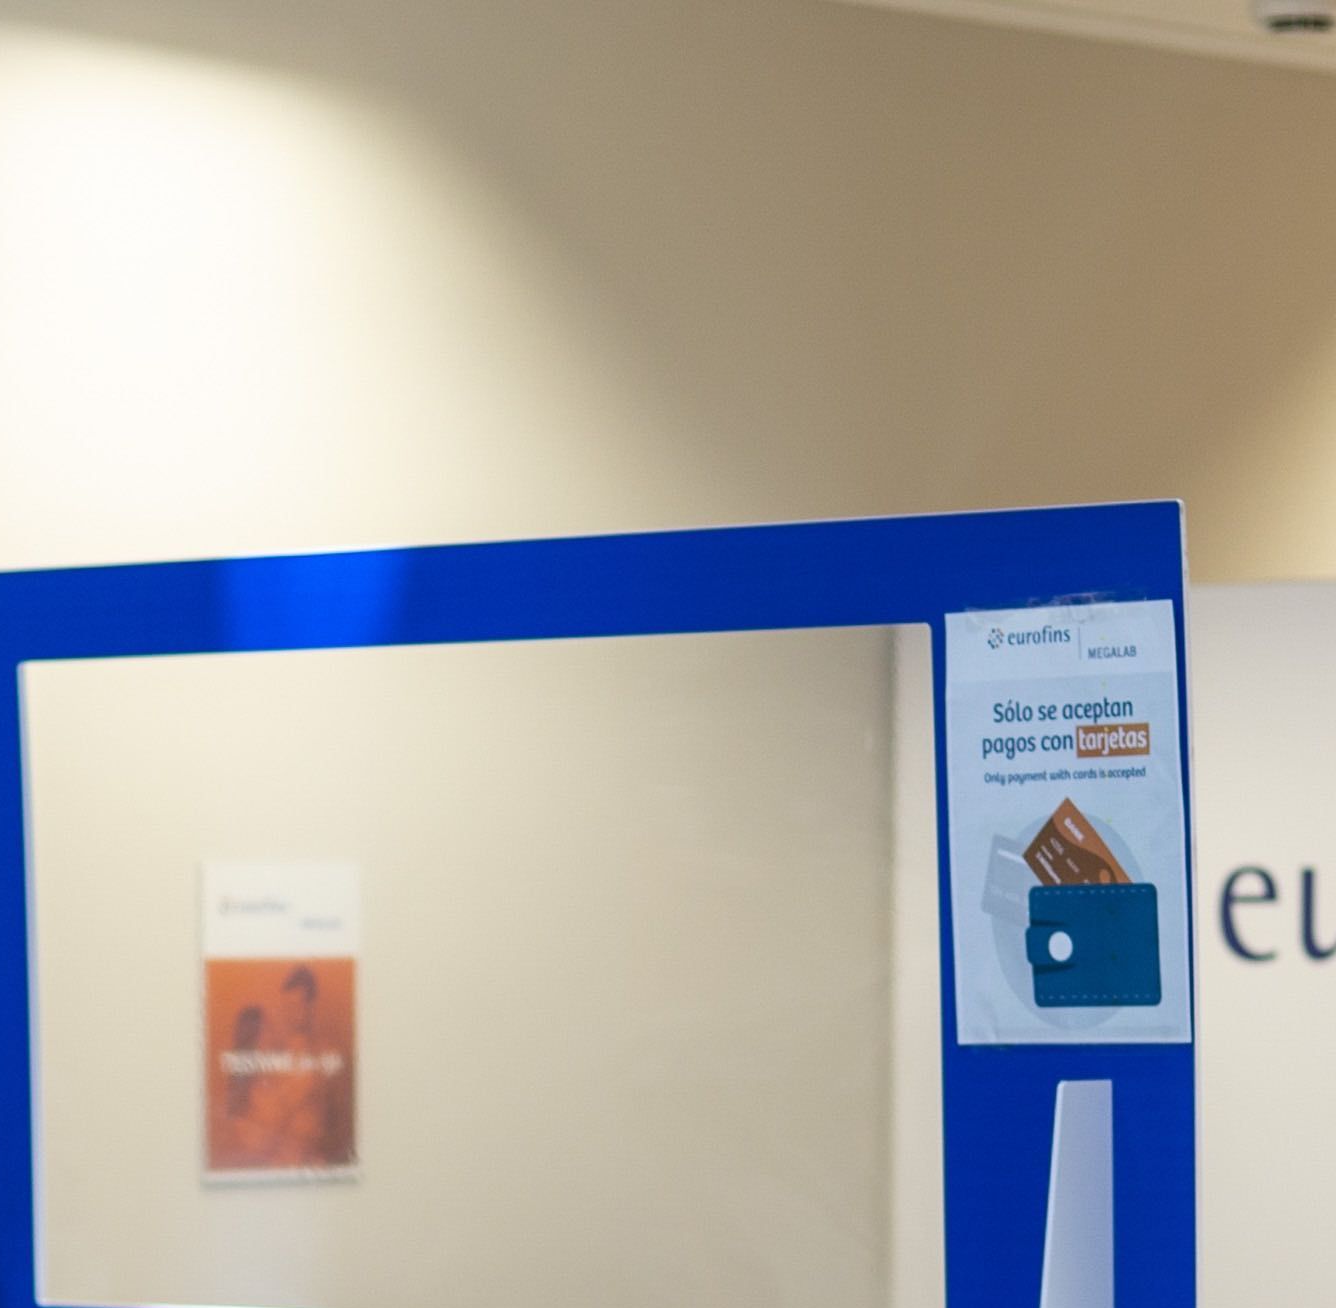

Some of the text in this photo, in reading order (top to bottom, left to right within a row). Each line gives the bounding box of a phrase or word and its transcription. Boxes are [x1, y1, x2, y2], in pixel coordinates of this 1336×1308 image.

[1007, 625, 1071, 645] eurofins
[1087, 645, 1137, 659] MEGALAB
[993, 697, 1134, 724] Sólo se aceptan
[982, 726, 1148, 760] pagos con tarjetas
[984, 766, 1147, 786] Only payment with cards is accepted
